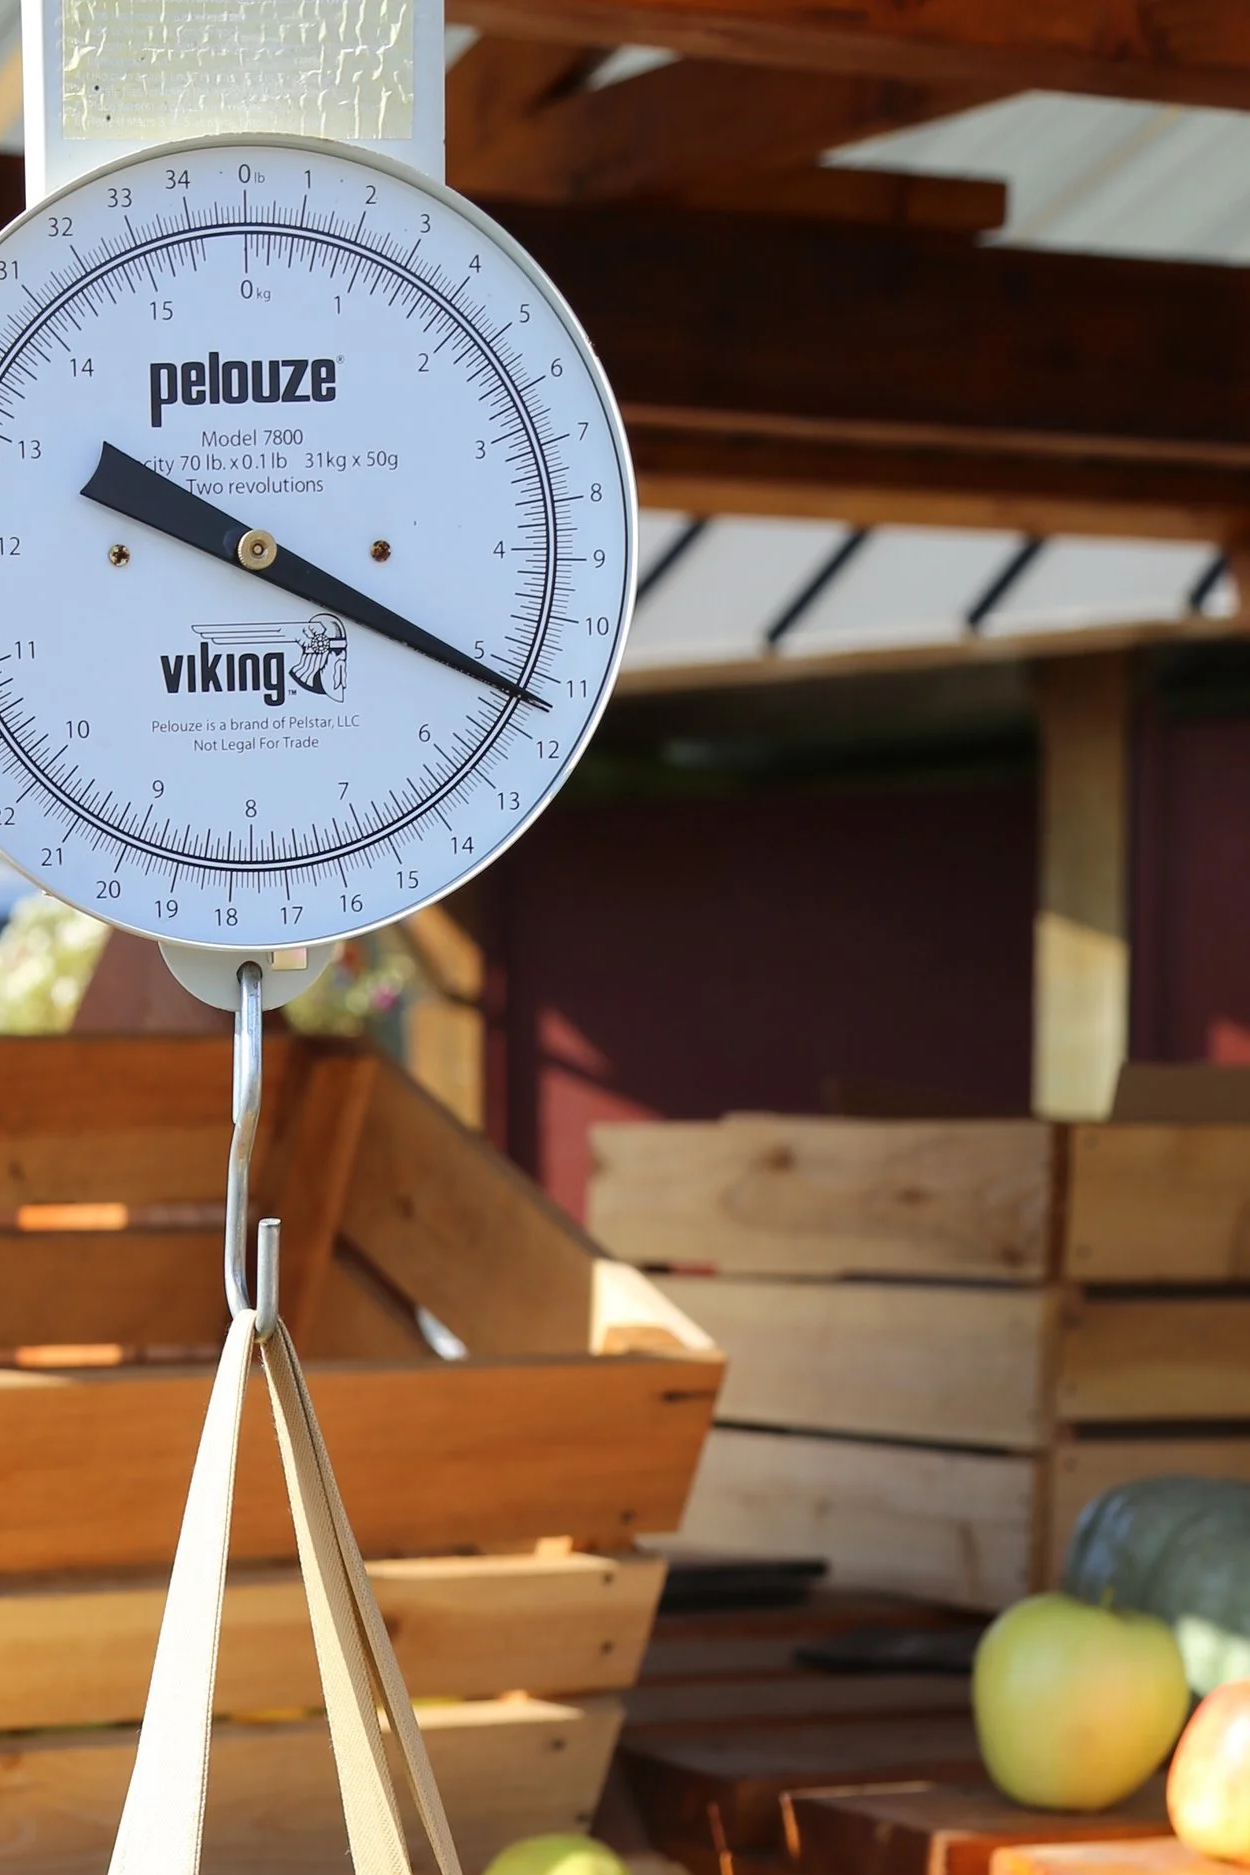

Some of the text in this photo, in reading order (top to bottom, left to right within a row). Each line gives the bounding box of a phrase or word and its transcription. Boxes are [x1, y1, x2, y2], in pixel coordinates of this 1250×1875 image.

[165, 169, 191, 190] 34
[238, 163, 266, 184] 0 lb
[304, 169, 311, 190] 1
[107, 187, 133, 208] 33
[365, 184, 377, 205] 2
[48, 216, 74, 238] 32
[419, 213, 431, 234] 3
[468, 253, 482, 274] 4
[240, 279, 271, 303] 0 kg
[149, 300, 174, 321] 15
[333, 295, 341, 315] 1
[519, 303, 531, 324] 5
[69, 357, 95, 378] 14
[417, 352, 430, 373] 2
[550, 357, 564, 378] 6
[150, 352, 336, 427] pelouze
[201, 429, 303, 447] Model 7800
[577, 421, 590, 441] 7
[17, 439, 42, 460] 13
[475, 439, 486, 460] 3
[180, 454, 200, 471] 70
[206, 453, 226, 471] lb.
[229, 458, 238, 470] x
[242, 453, 266, 470] 0.1
[271, 452, 288, 469] lb
[304, 452, 347, 471] 31kg
[351, 456, 361, 467] x
[366, 450, 398, 471] 50g
[186, 476, 324, 495] Two revolutions
[590, 482, 603, 503] 8
[492, 540, 506, 560] 4
[592, 548, 606, 569] 9
[585, 616, 610, 636] 10
[14, 640, 35, 660] 11
[473, 640, 485, 660] 5
[160, 641, 285, 707] viking
[566, 679, 587, 699] 11
[65, 719, 90, 739] 10
[151, 715, 360, 733] Pelouze is a brand of Pelstar, LLC
[418, 723, 431, 743] 6
[193, 736, 319, 753] Not Legal For Trade
[536, 739, 560, 760] 12
[152, 779, 165, 799] 9
[337, 781, 350, 801] 7
[244, 798, 258, 819] 8
[497, 791, 520, 811] 13
[450, 835, 475, 855] 14
[41, 847, 63, 867] 21
[95, 879, 121, 900] 20
[396, 870, 419, 890] 15
[154, 899, 179, 919] 19
[339, 893, 364, 913] 16
[214, 907, 239, 927] 18
[280, 905, 304, 925] 17
